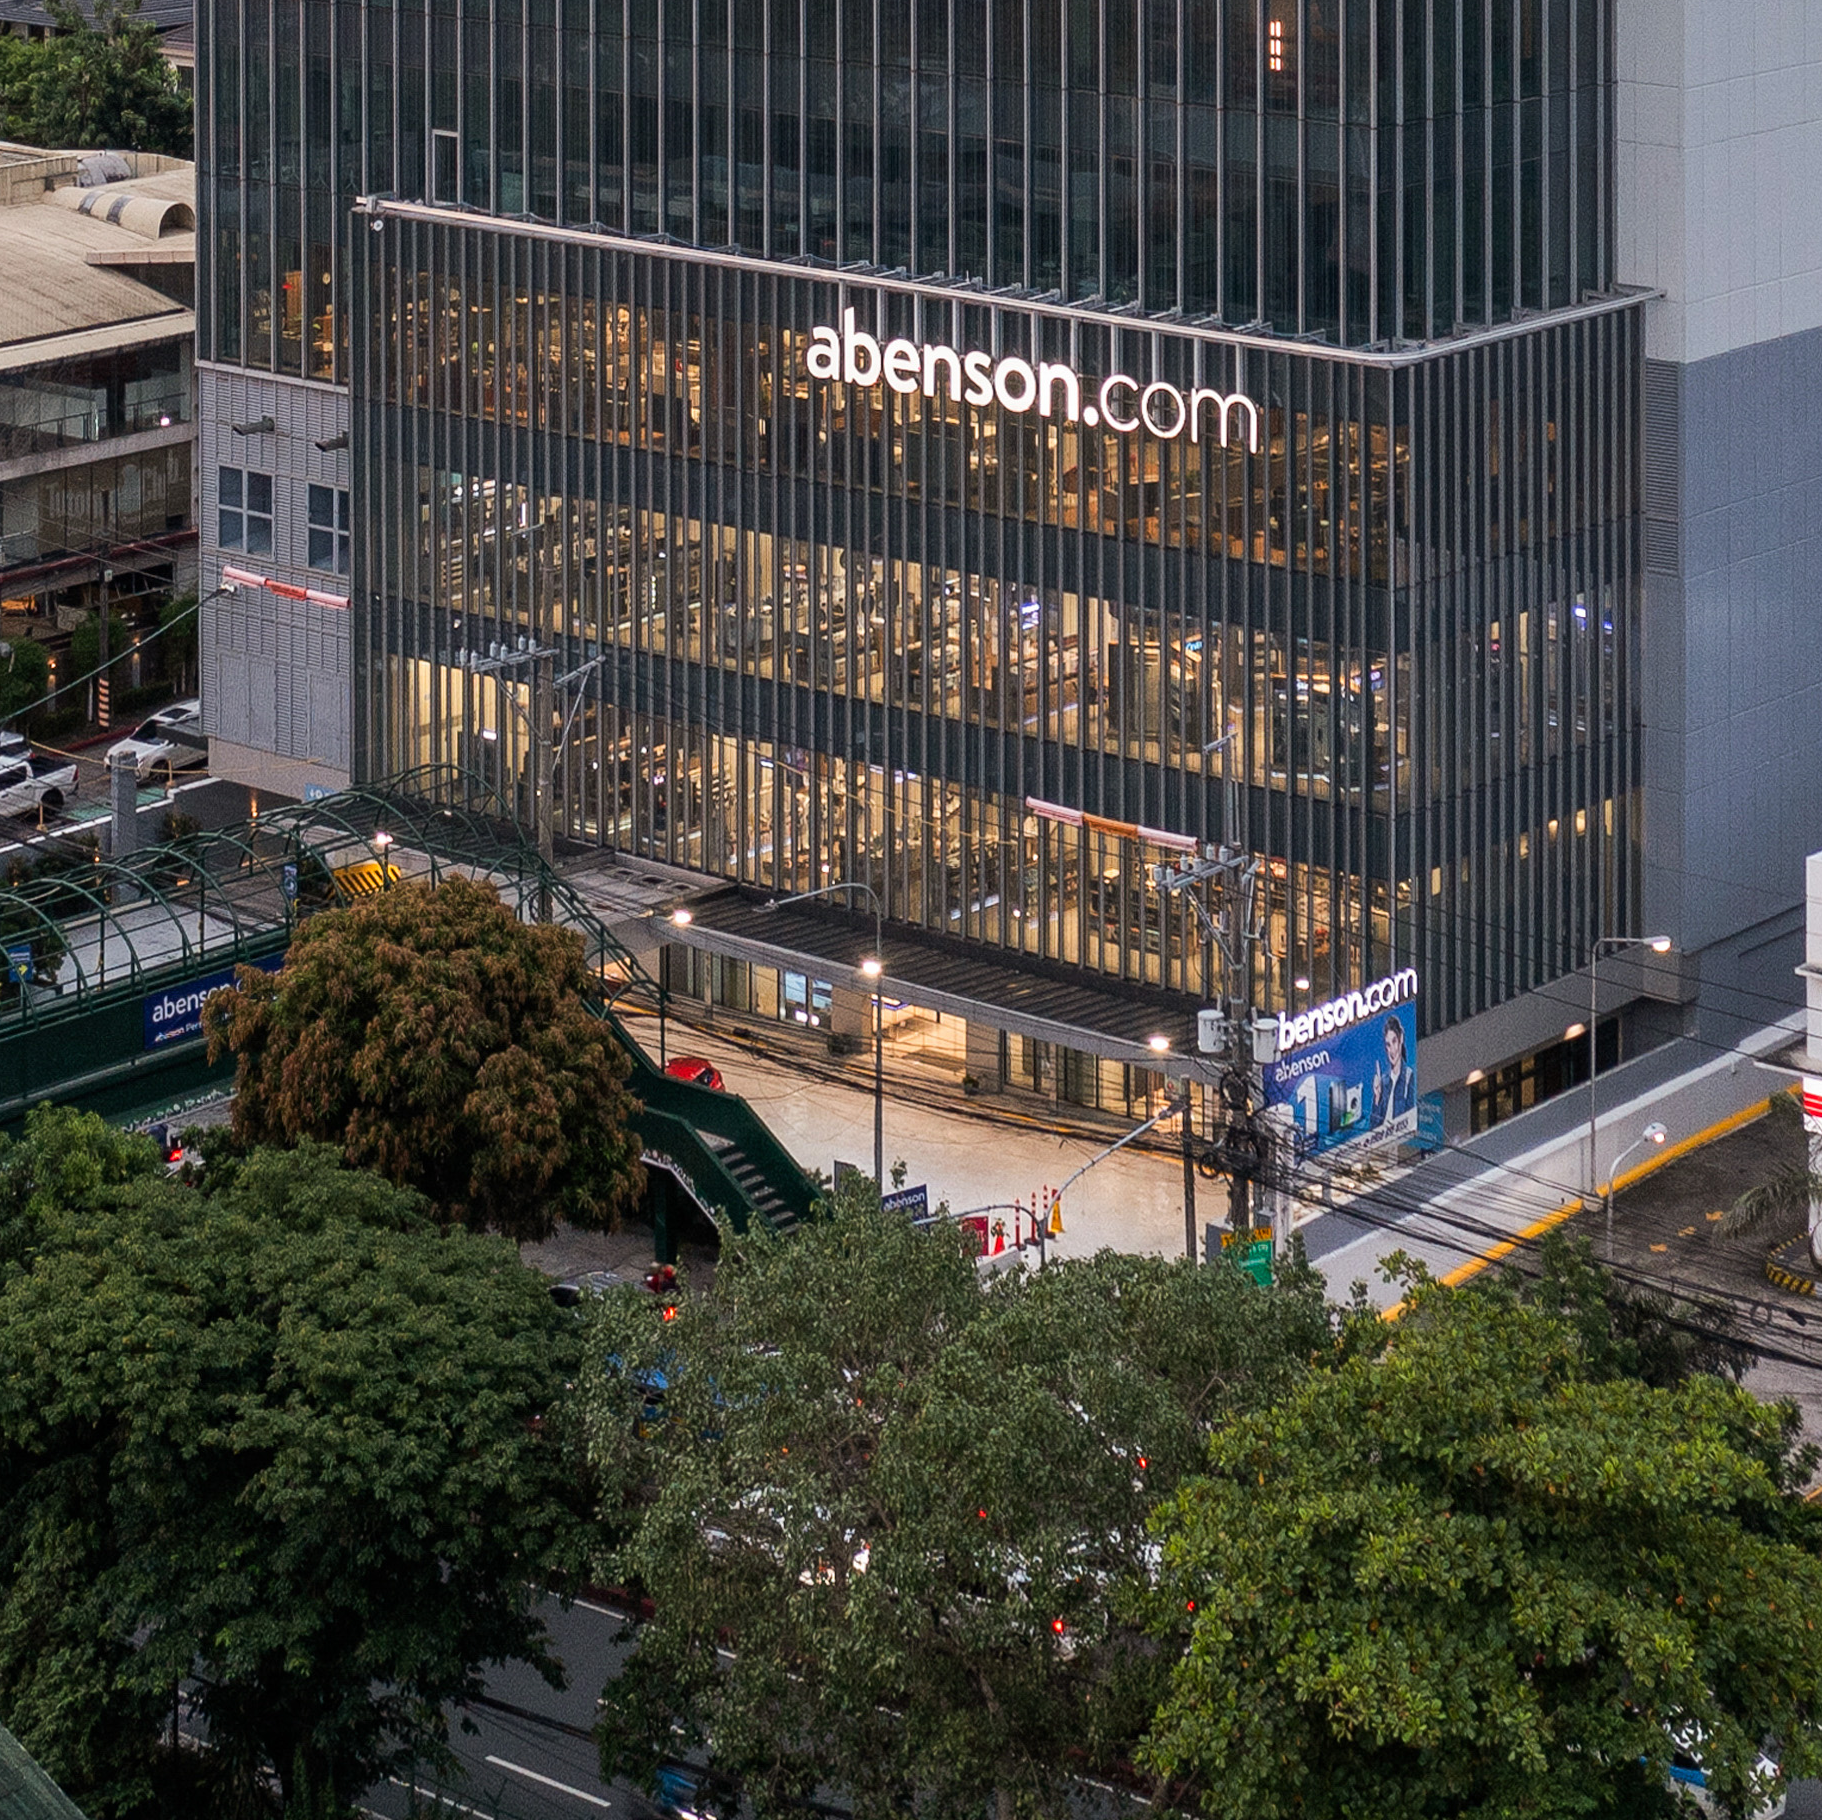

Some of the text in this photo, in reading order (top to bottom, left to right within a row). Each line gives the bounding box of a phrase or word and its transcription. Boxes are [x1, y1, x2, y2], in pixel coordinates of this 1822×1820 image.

[805, 306, 1259, 455] abenson.com
[1277, 966, 1418, 1052] benson.com
[1275, 1048, 1331, 1083] abenson
